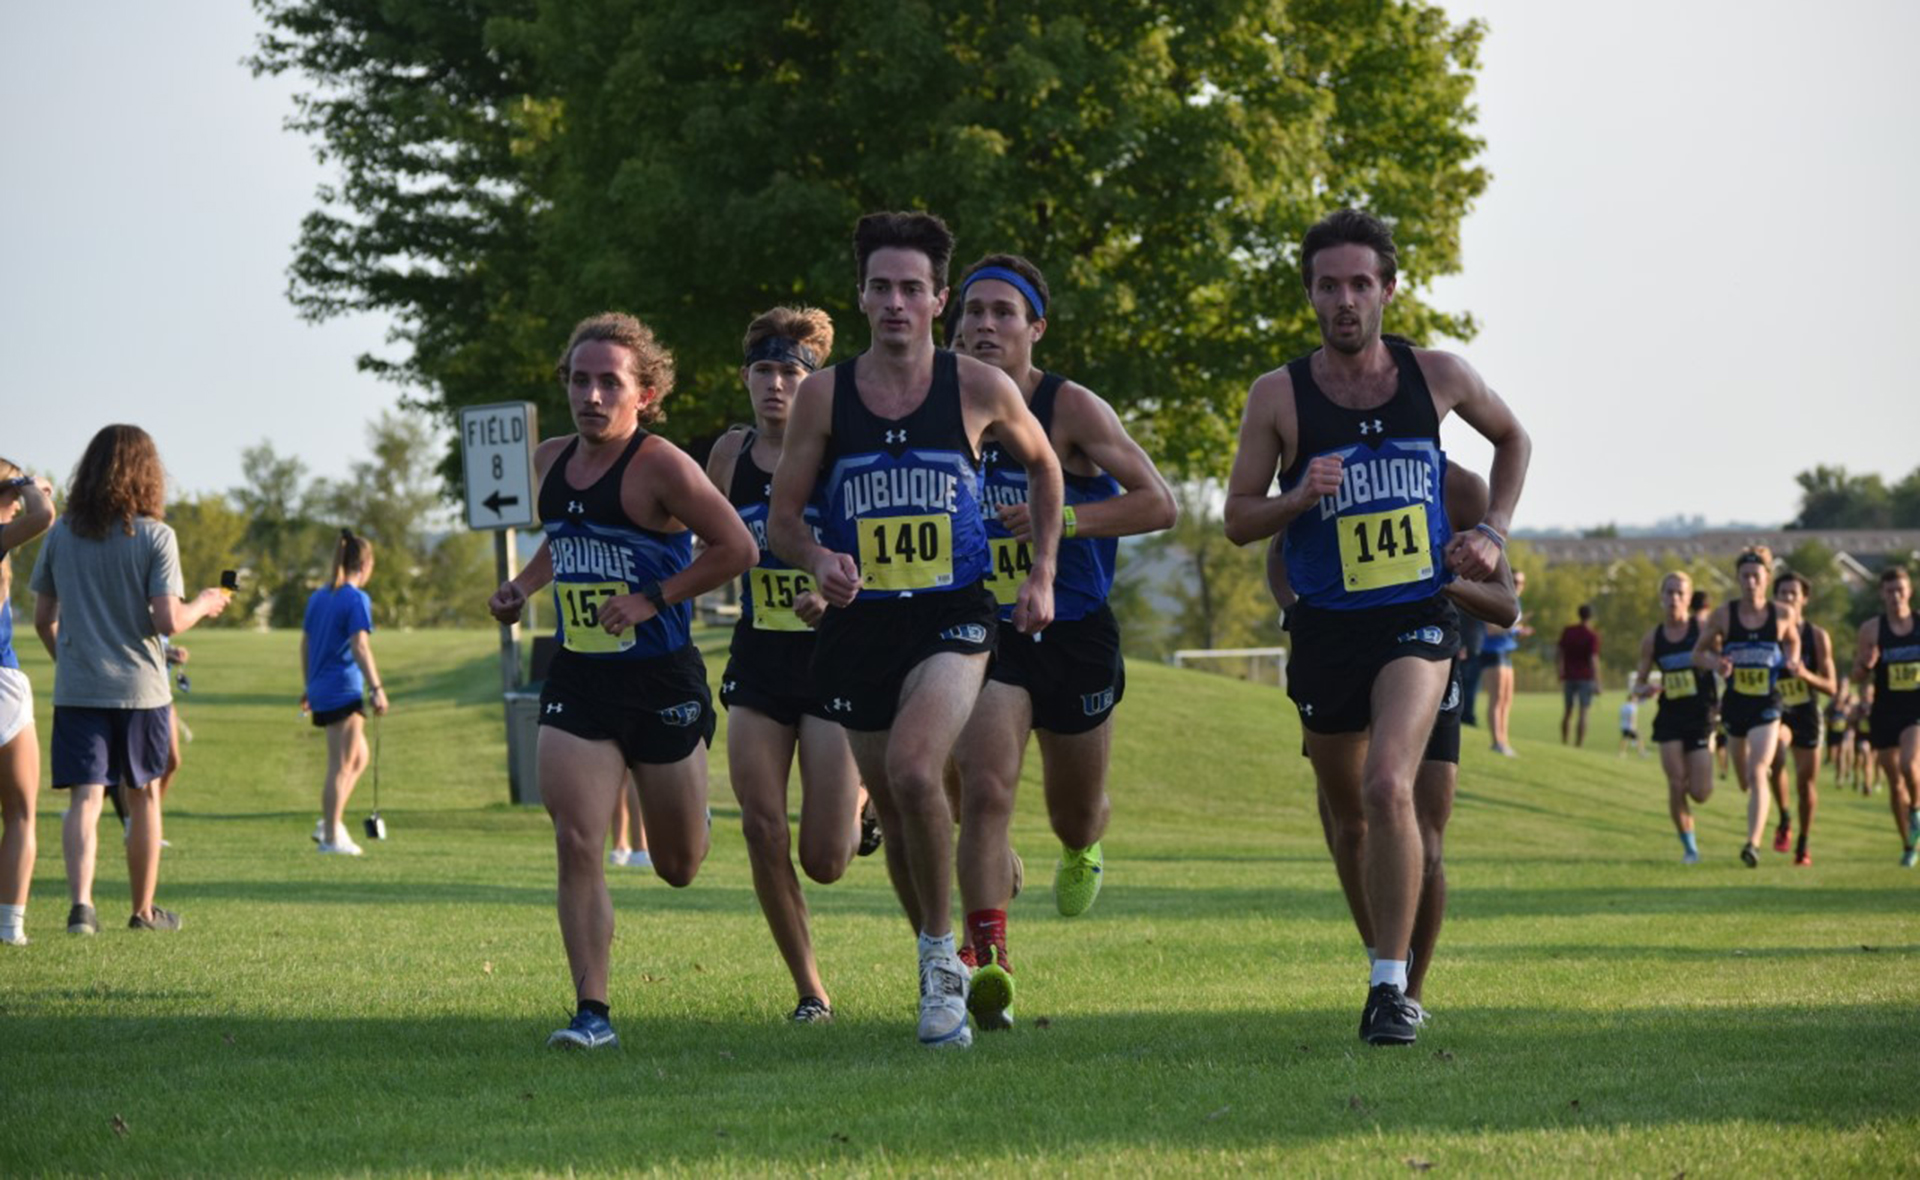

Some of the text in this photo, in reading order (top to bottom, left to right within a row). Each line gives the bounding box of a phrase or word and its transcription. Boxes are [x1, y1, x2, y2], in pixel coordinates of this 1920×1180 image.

[467, 416, 523, 447] FIELD
[492, 453, 503, 480] 8
[844, 467, 958, 521] DUBUQUE
[873, 522, 938, 564] 140
[1354, 514, 1418, 563] 141
[550, 537, 639, 583] UBUQUE
[984, 543, 1033, 581] 44
